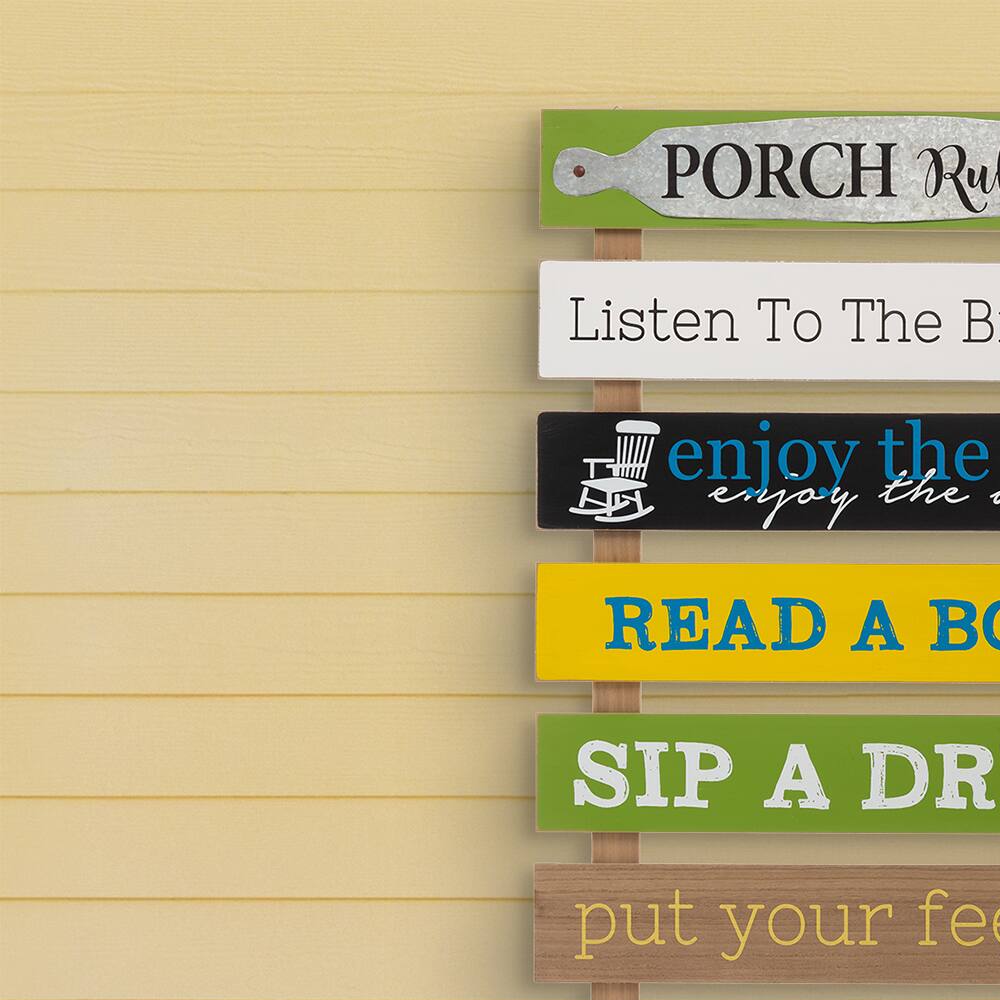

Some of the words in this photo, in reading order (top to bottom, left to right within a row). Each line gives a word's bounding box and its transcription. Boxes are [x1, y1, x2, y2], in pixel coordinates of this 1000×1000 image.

[661, 142, 897, 200] PORCH
[568, 297, 739, 343] Listen
[757, 297, 823, 343] To
[841, 297, 941, 343] The
[668, 420, 860, 499] enjoy
[877, 419, 990, 482] the
[707, 473, 859, 530] enjoy
[877, 467, 971, 504] the
[604, 596, 827, 652] READ
[849, 598, 904, 653] A
[573, 739, 734, 809] SIP
[763, 743, 831, 810] A
[574, 888, 698, 960] put
[719, 902, 893, 961] your
